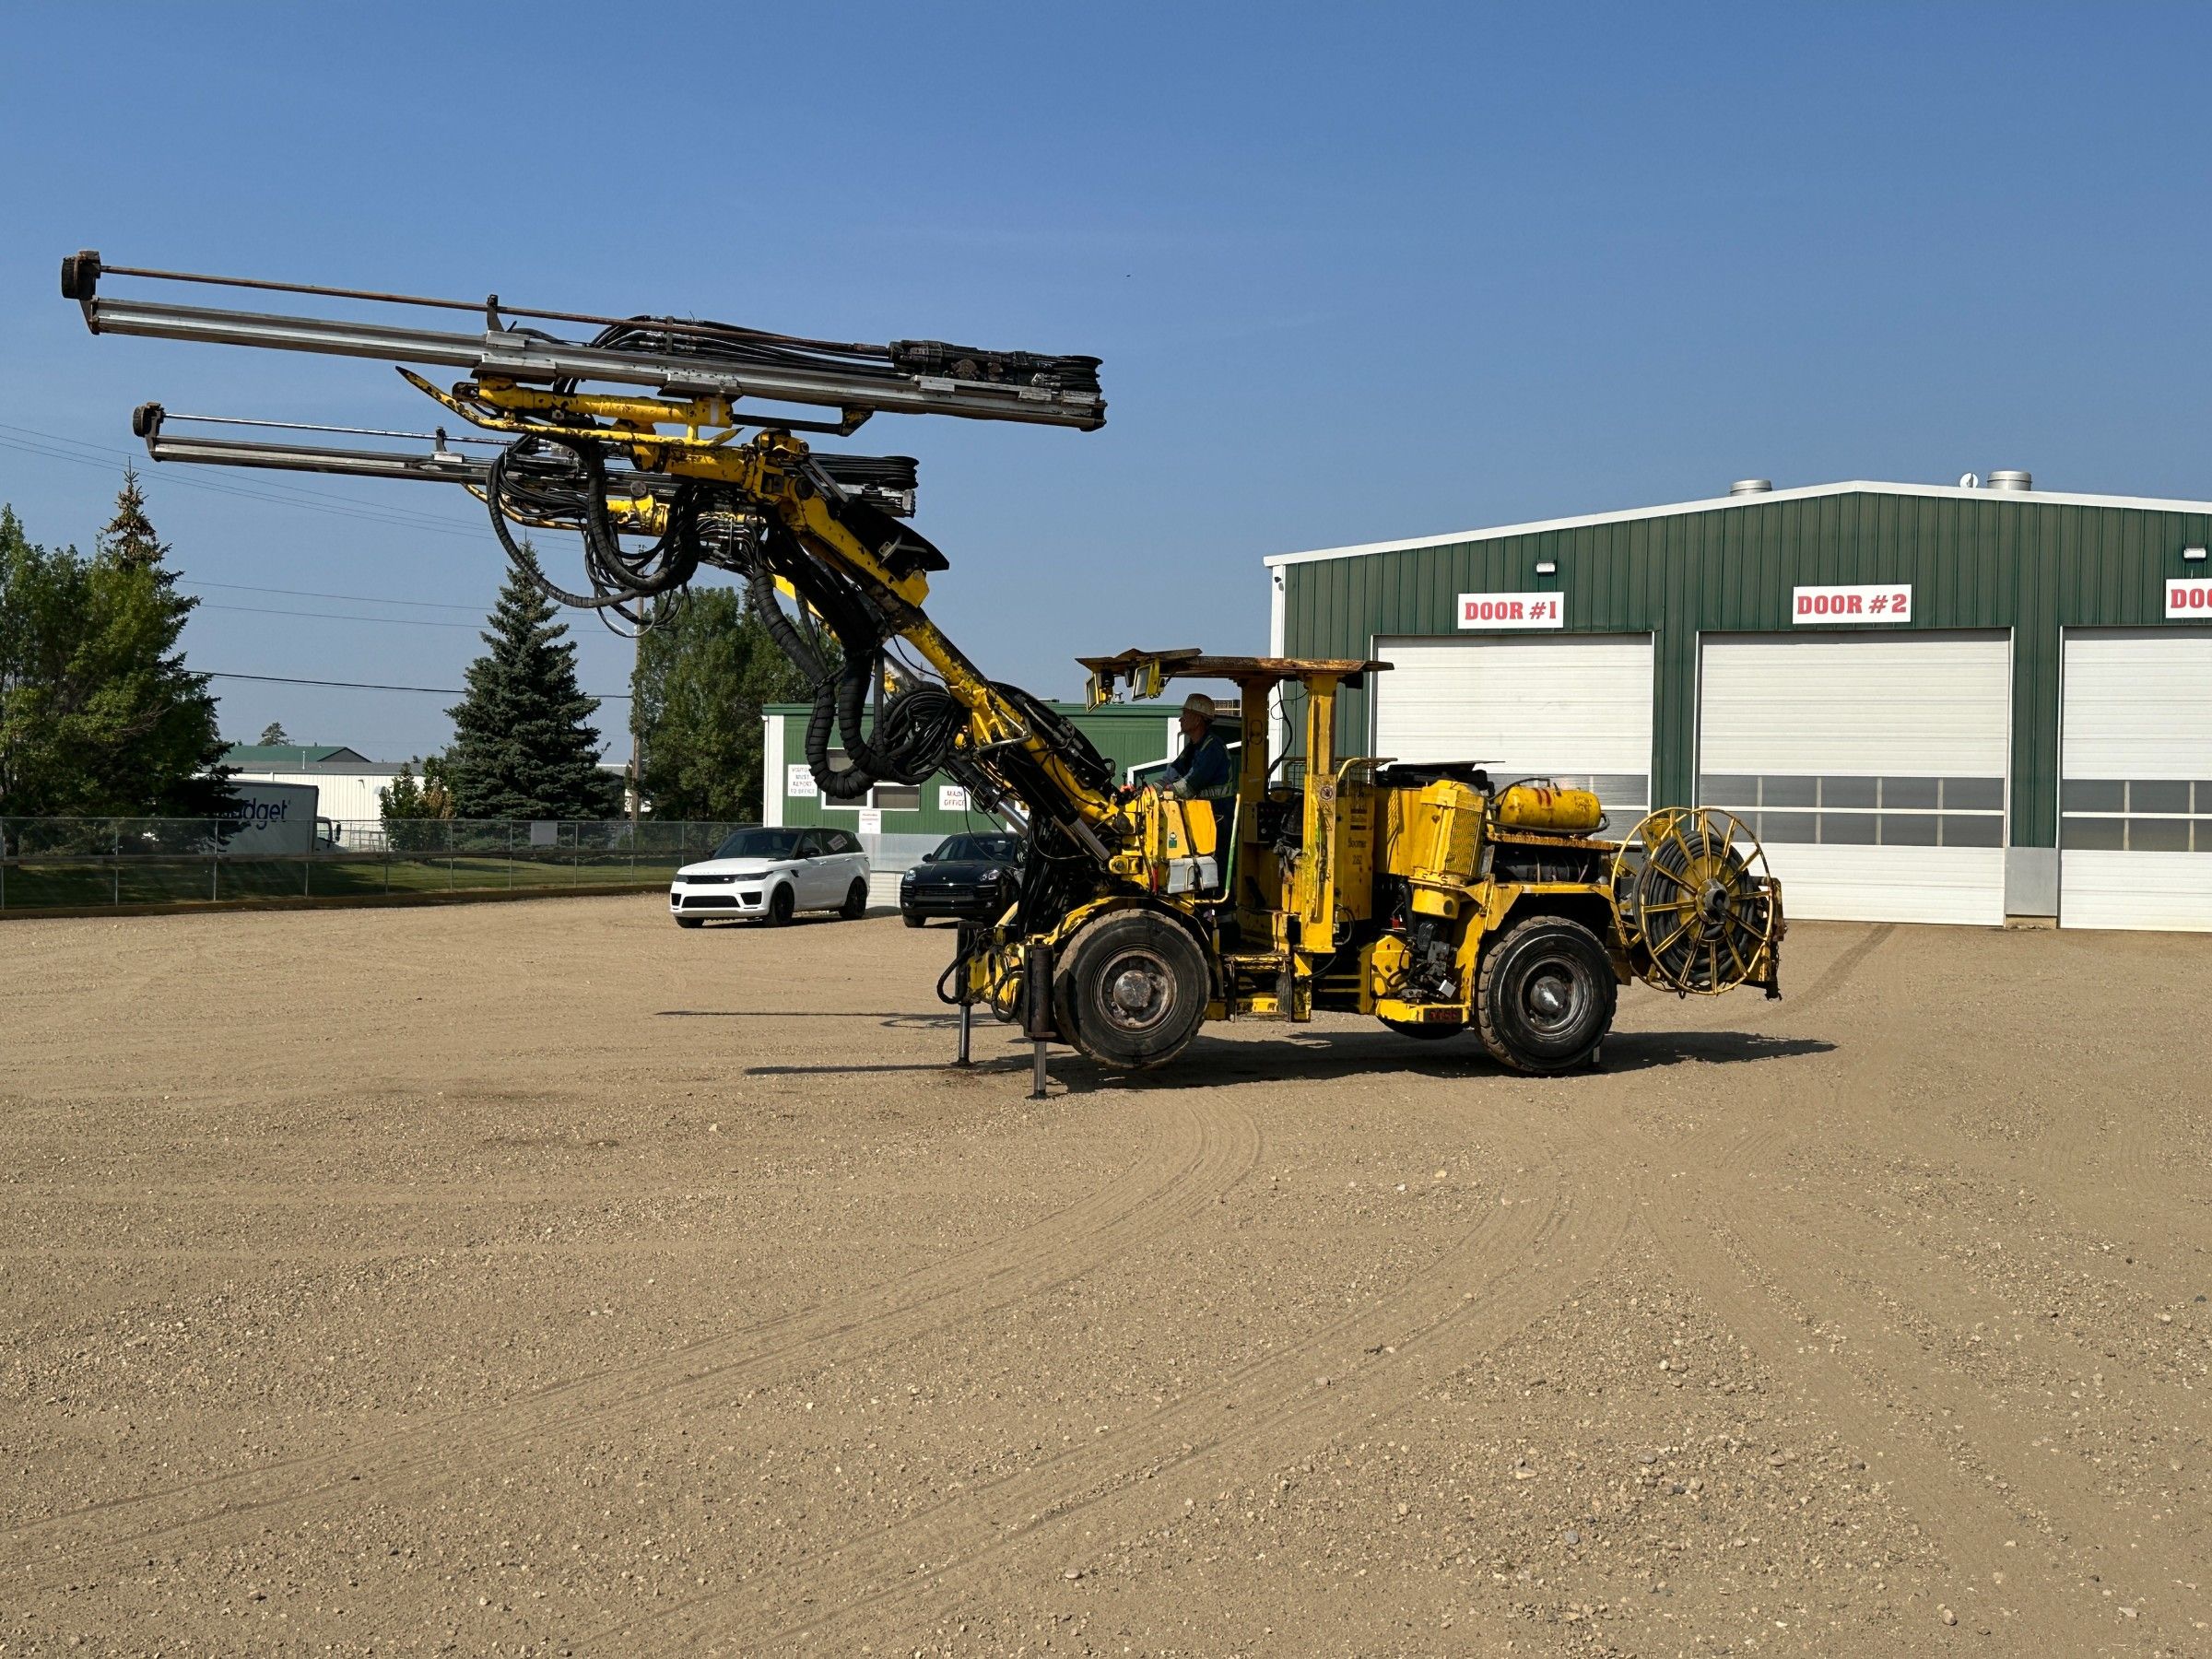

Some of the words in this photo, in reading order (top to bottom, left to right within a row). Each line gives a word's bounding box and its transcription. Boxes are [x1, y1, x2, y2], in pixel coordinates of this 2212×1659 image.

[1465, 602, 1524, 620] DOOR
[1529, 601, 1557, 619] #1
[1796, 594, 1863, 615] DOOR
[1868, 594, 1907, 614] #2
[234, 797, 288, 830] dget
